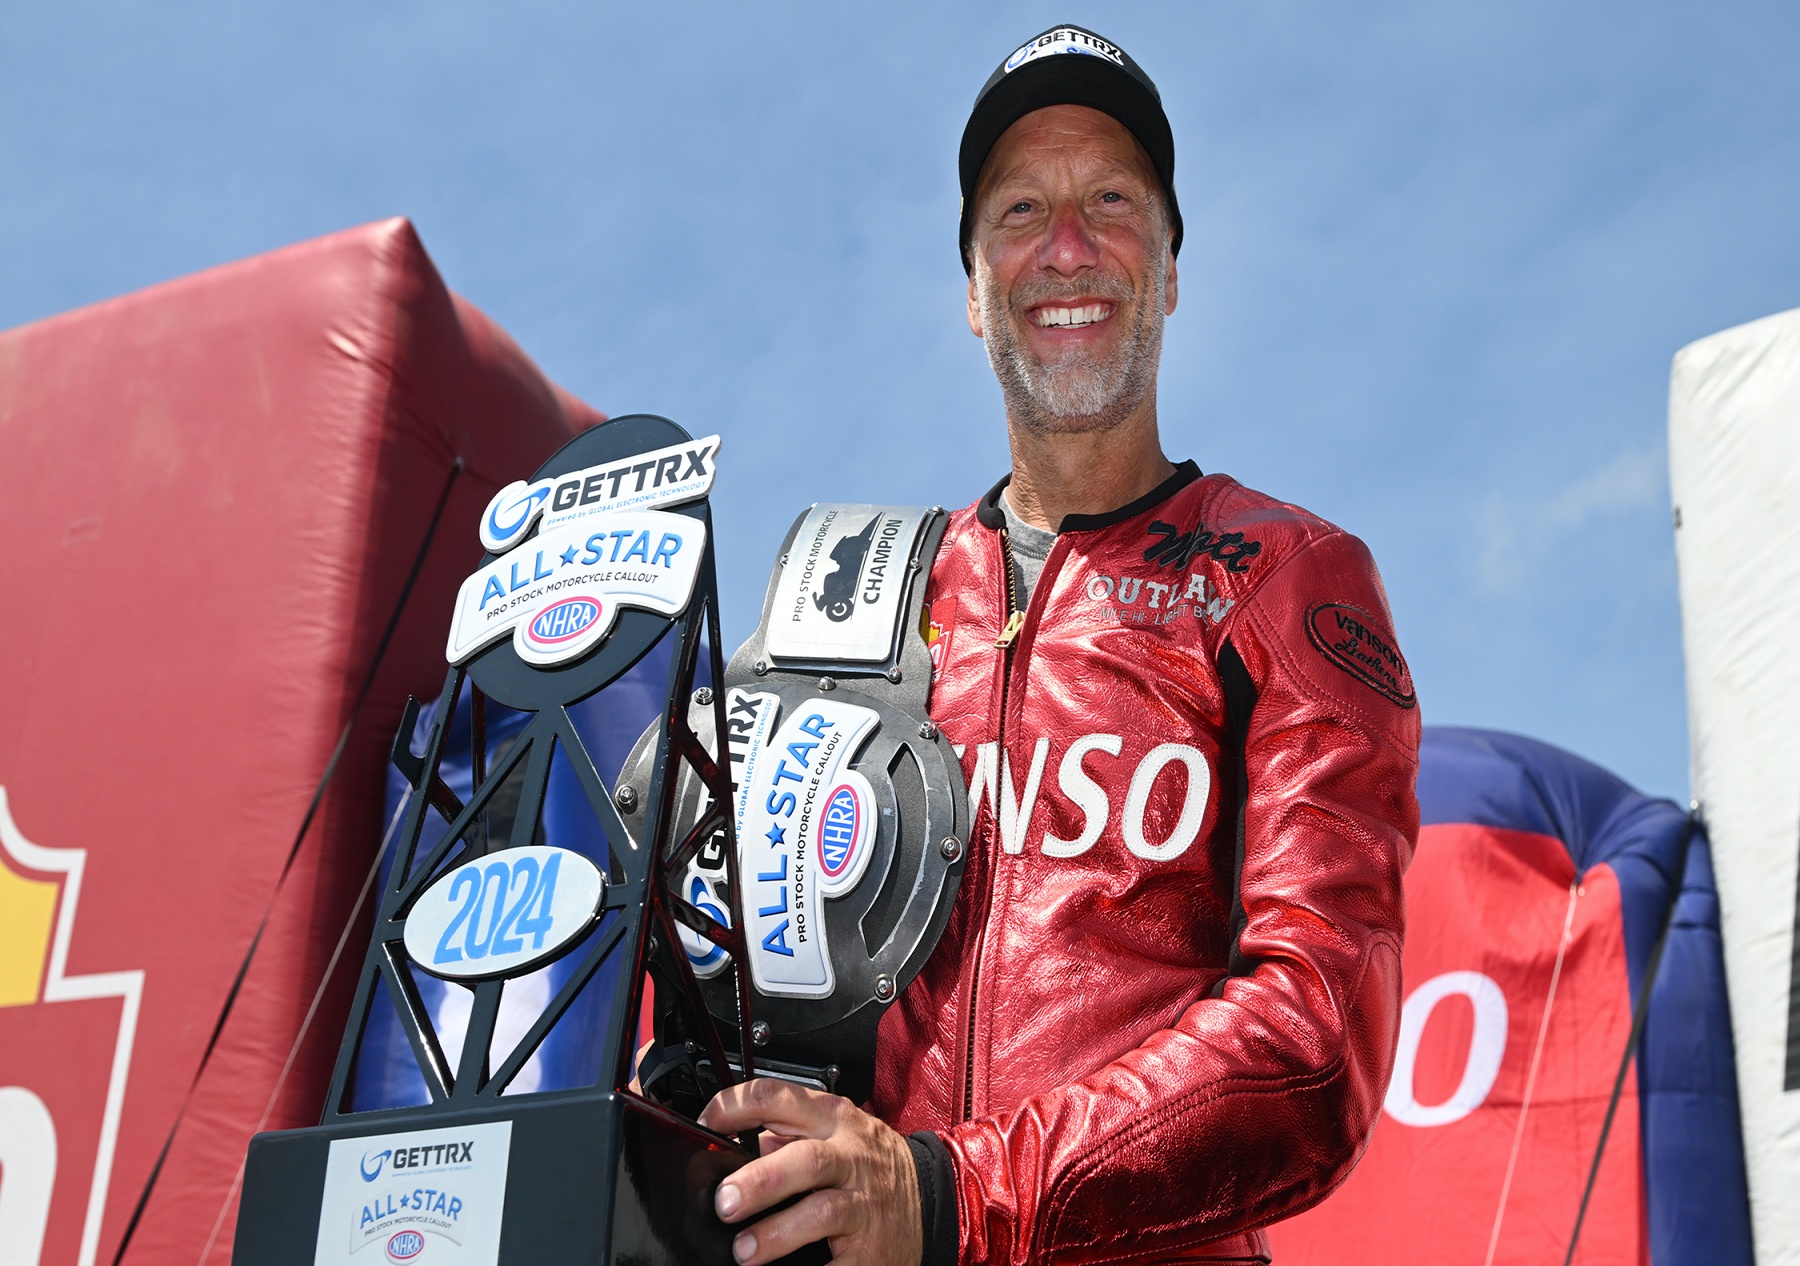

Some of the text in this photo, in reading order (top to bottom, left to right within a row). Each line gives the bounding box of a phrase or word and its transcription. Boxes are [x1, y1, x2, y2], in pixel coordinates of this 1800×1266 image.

[1038, 31, 1121, 61] GETTRX
[547, 480, 706, 526] powered by GLOBAL ELECTRONIC TECHNOLOGY
[551, 445, 713, 512] GETTRX
[479, 529, 683, 611] ALL STAR
[792, 510, 838, 622] PRO STOCK MOTORCYCLE
[863, 519, 903, 605] CHAMPION
[486, 571, 659, 621] PRO STOCK MOTORCYCLE CALLOUT
[538, 603, 591, 636] NHRA
[1086, 573, 1236, 623] OUTLAW
[697, 695, 763, 870] GRX
[738, 785, 750, 817] GLOBAL
[745, 737, 761, 783] ELECTRONIC
[755, 699, 773, 741] TECHNOLOGY
[824, 796, 854, 862] NHRA
[952, 733, 1211, 862] NSO
[757, 713, 836, 958] ALL STAR
[795, 731, 843, 943] PRO STOCK MOTORCYCLE CALLOUT
[433, 852, 563, 965] 2024
[393, 1141, 475, 1169] GETTRX
[360, 1188, 463, 1229] ALL STAR
[364, 1216, 452, 1237] PRO STOCK MOTORCYCLE CALLOUT
[392, 1234, 420, 1256] NHRA
